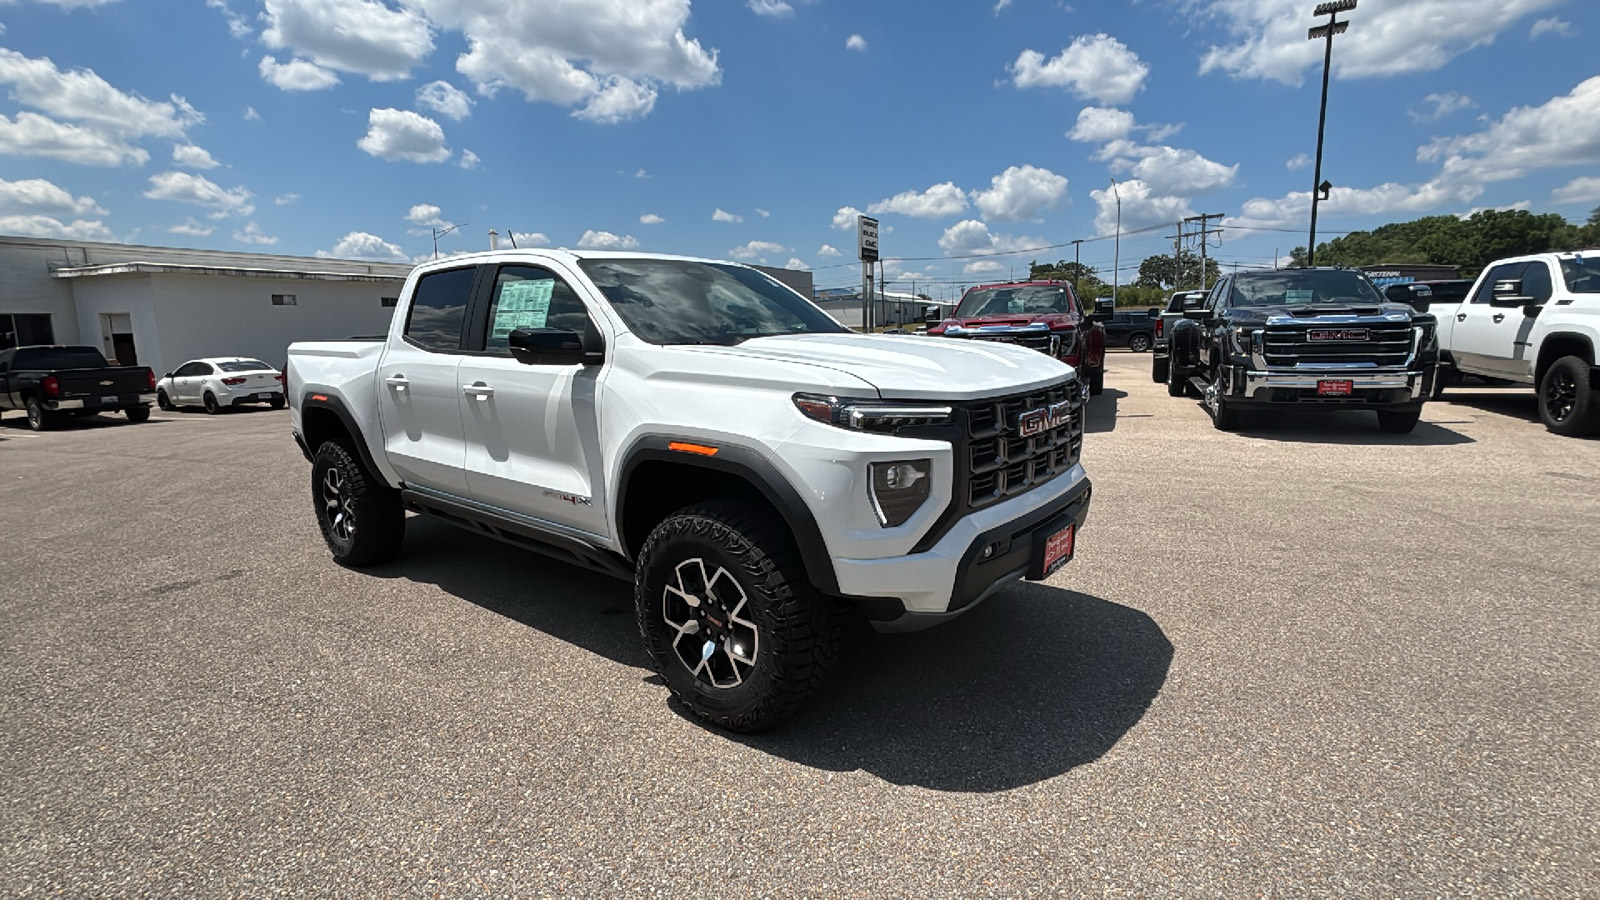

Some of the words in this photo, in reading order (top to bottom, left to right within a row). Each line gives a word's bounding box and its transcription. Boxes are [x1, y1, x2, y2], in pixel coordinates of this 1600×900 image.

[1311, 330, 1366, 339] GMC
[1019, 400, 1070, 438] GMC
[543, 490, 593, 507] 4X
